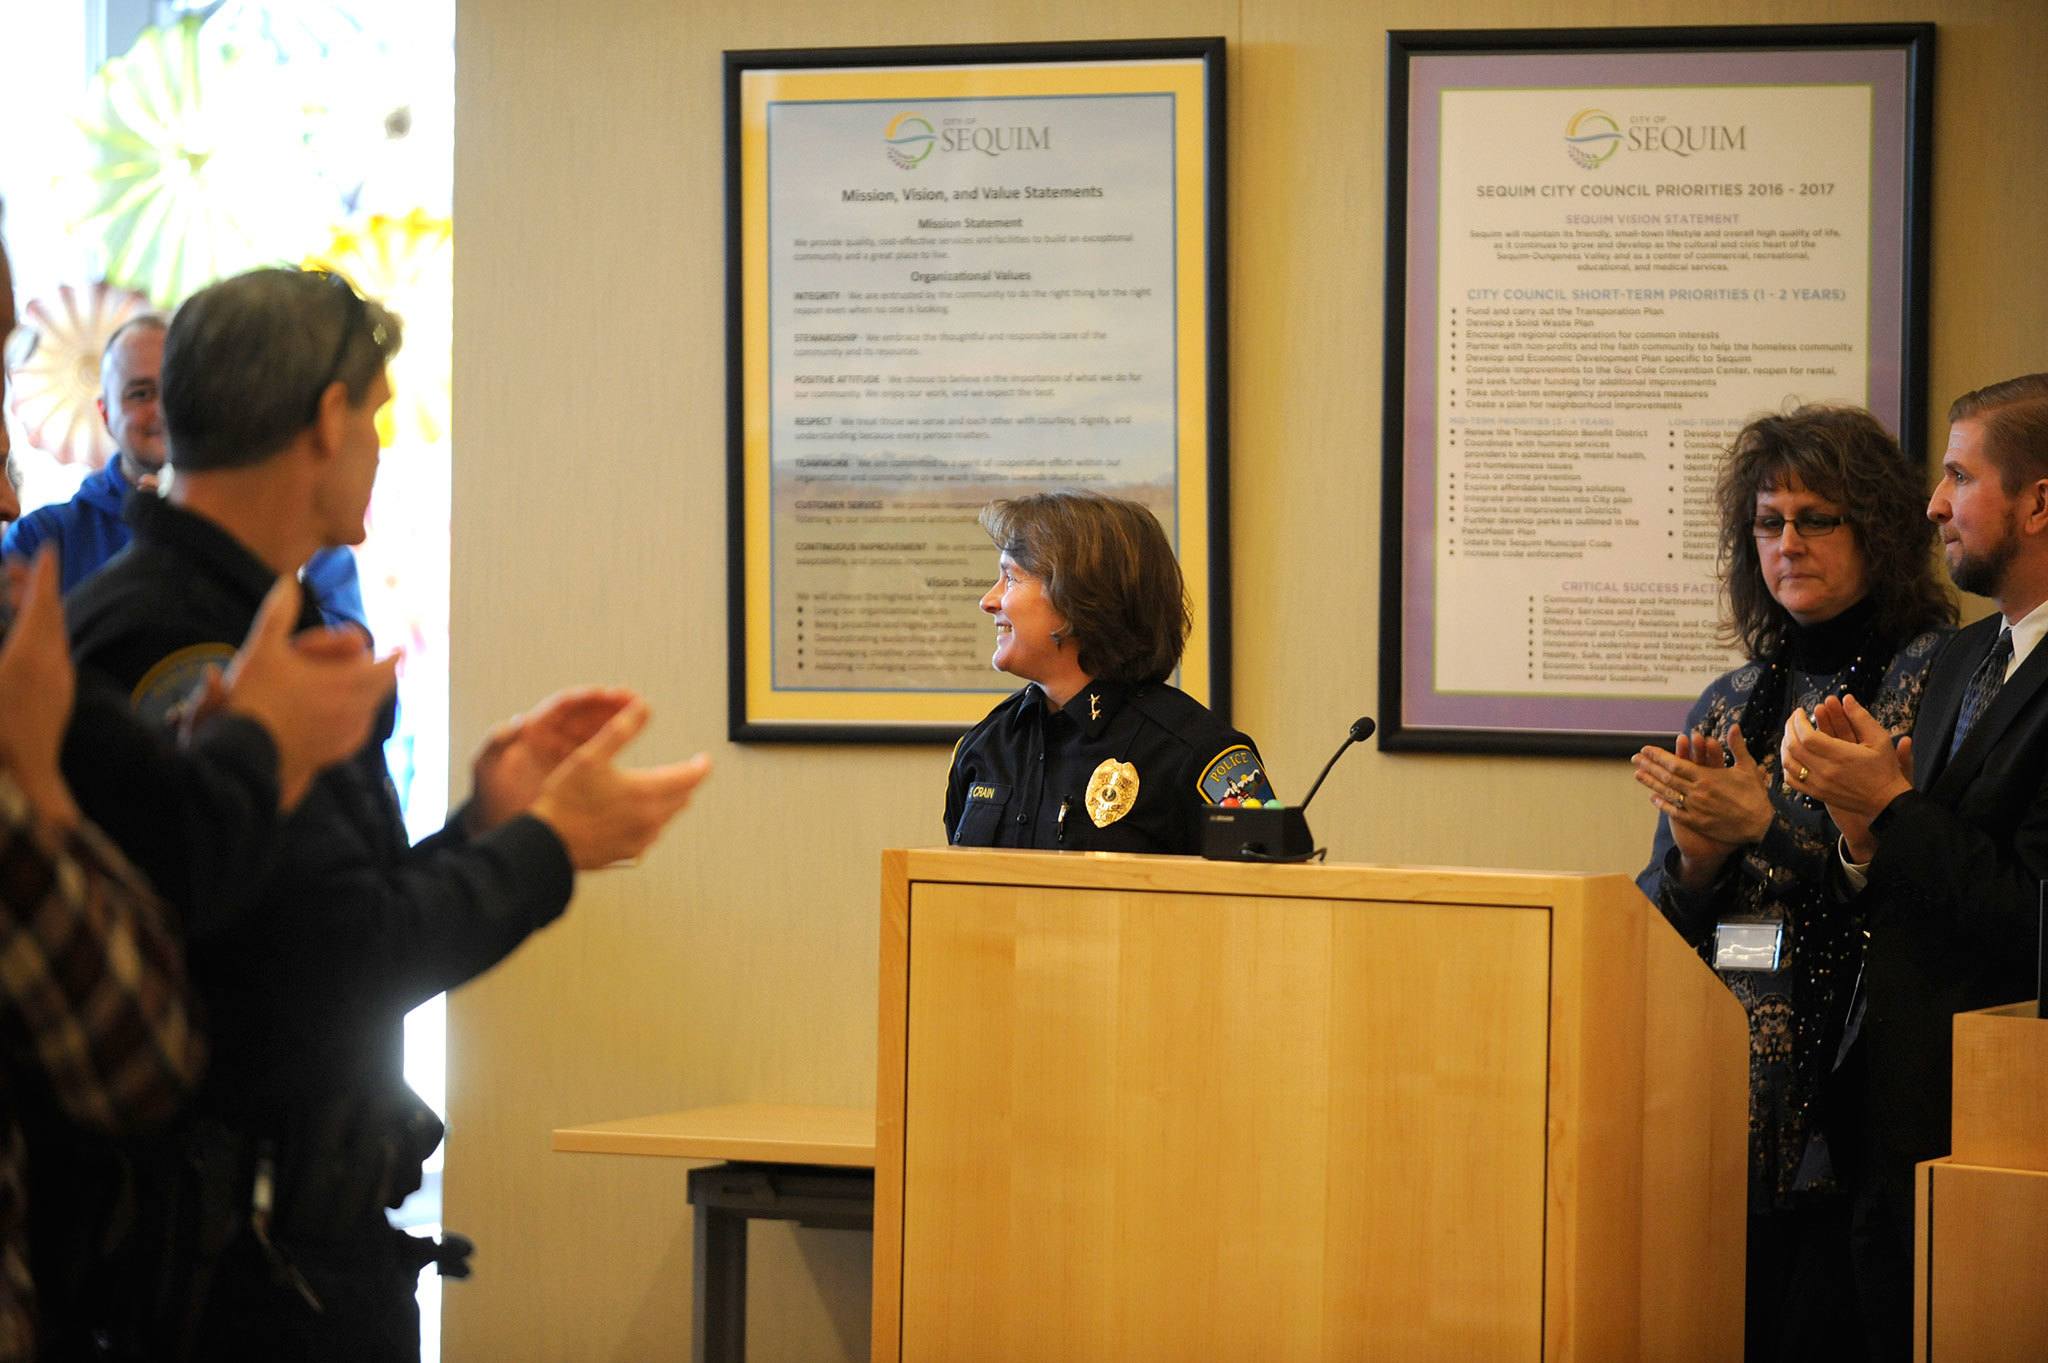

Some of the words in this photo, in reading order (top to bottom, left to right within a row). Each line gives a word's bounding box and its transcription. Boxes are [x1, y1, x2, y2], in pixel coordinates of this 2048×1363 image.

[1630, 115, 1650, 123] CITY
[1653, 115, 1666, 123] OF
[941, 127, 1051, 156] SEQUIM
[1627, 126, 1746, 157] SEQUIM
[841, 189, 898, 202] Mission,
[903, 188, 949, 201] Vision,
[953, 188, 979, 200] and
[982, 187, 1020, 200] Value
[1024, 186, 1103, 199] Statements
[1476, 186, 1536, 197] SEQUIM
[1540, 185, 1575, 197] CITY
[1581, 185, 1649, 196] COUNCIL
[1656, 184, 1743, 196] PRIORITIES
[1749, 184, 1783, 195] 2016
[1800, 183, 1834, 195] 2017
[918, 219, 961, 228] Mission
[965, 218, 1023, 227] Statement
[1566, 215, 1614, 224] SEQUIM
[1618, 215, 1661, 224] VISION
[1665, 214, 1739, 224] STATEMENT
[911, 271, 992, 282] Organizational
[994, 271, 1031, 281] Values
[1467, 289, 1499, 300] CITY
[1504, 289, 1566, 300] COUNCIL
[1572, 289, 1665, 300] SHORT-TERM
[1669, 289, 1749, 300] PRIORITIES
[1779, 289, 1787, 300] 2
[1793, 289, 1846, 300] YEARS)
[1210, 752, 1248, 782] POLICE
[973, 785, 995, 799] CRAIN
